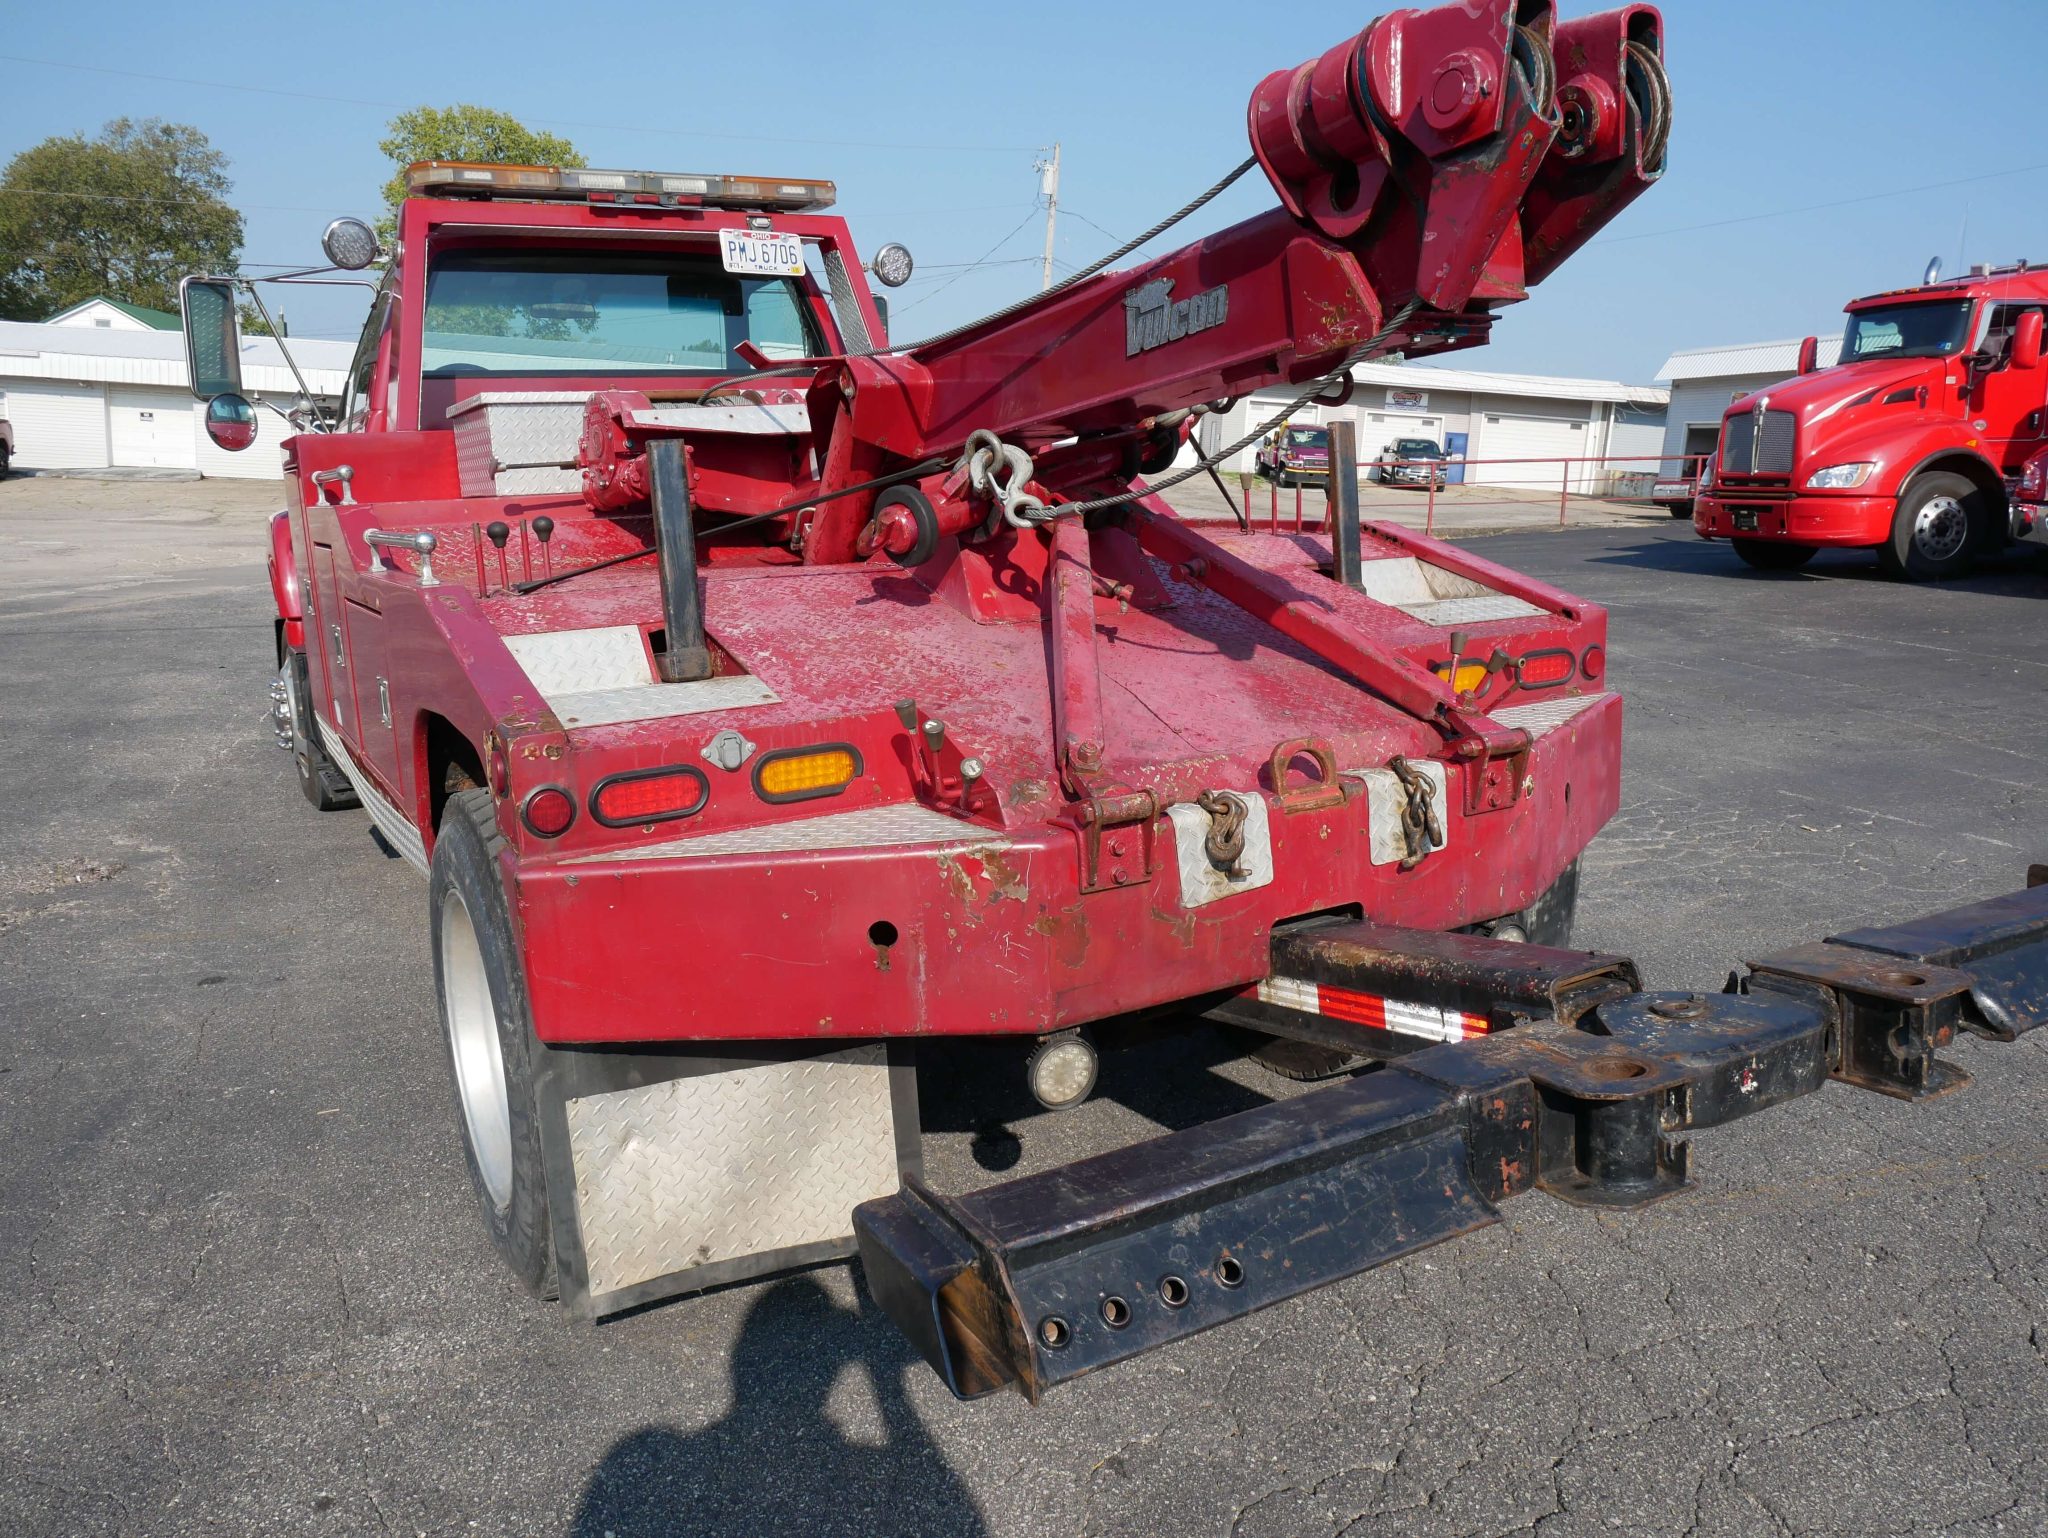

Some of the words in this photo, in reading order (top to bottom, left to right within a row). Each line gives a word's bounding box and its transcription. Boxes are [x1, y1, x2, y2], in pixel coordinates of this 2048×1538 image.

[751, 233, 771, 241] OHIO
[728, 240, 757, 263] PMJ
[761, 243, 798, 265] 6706
